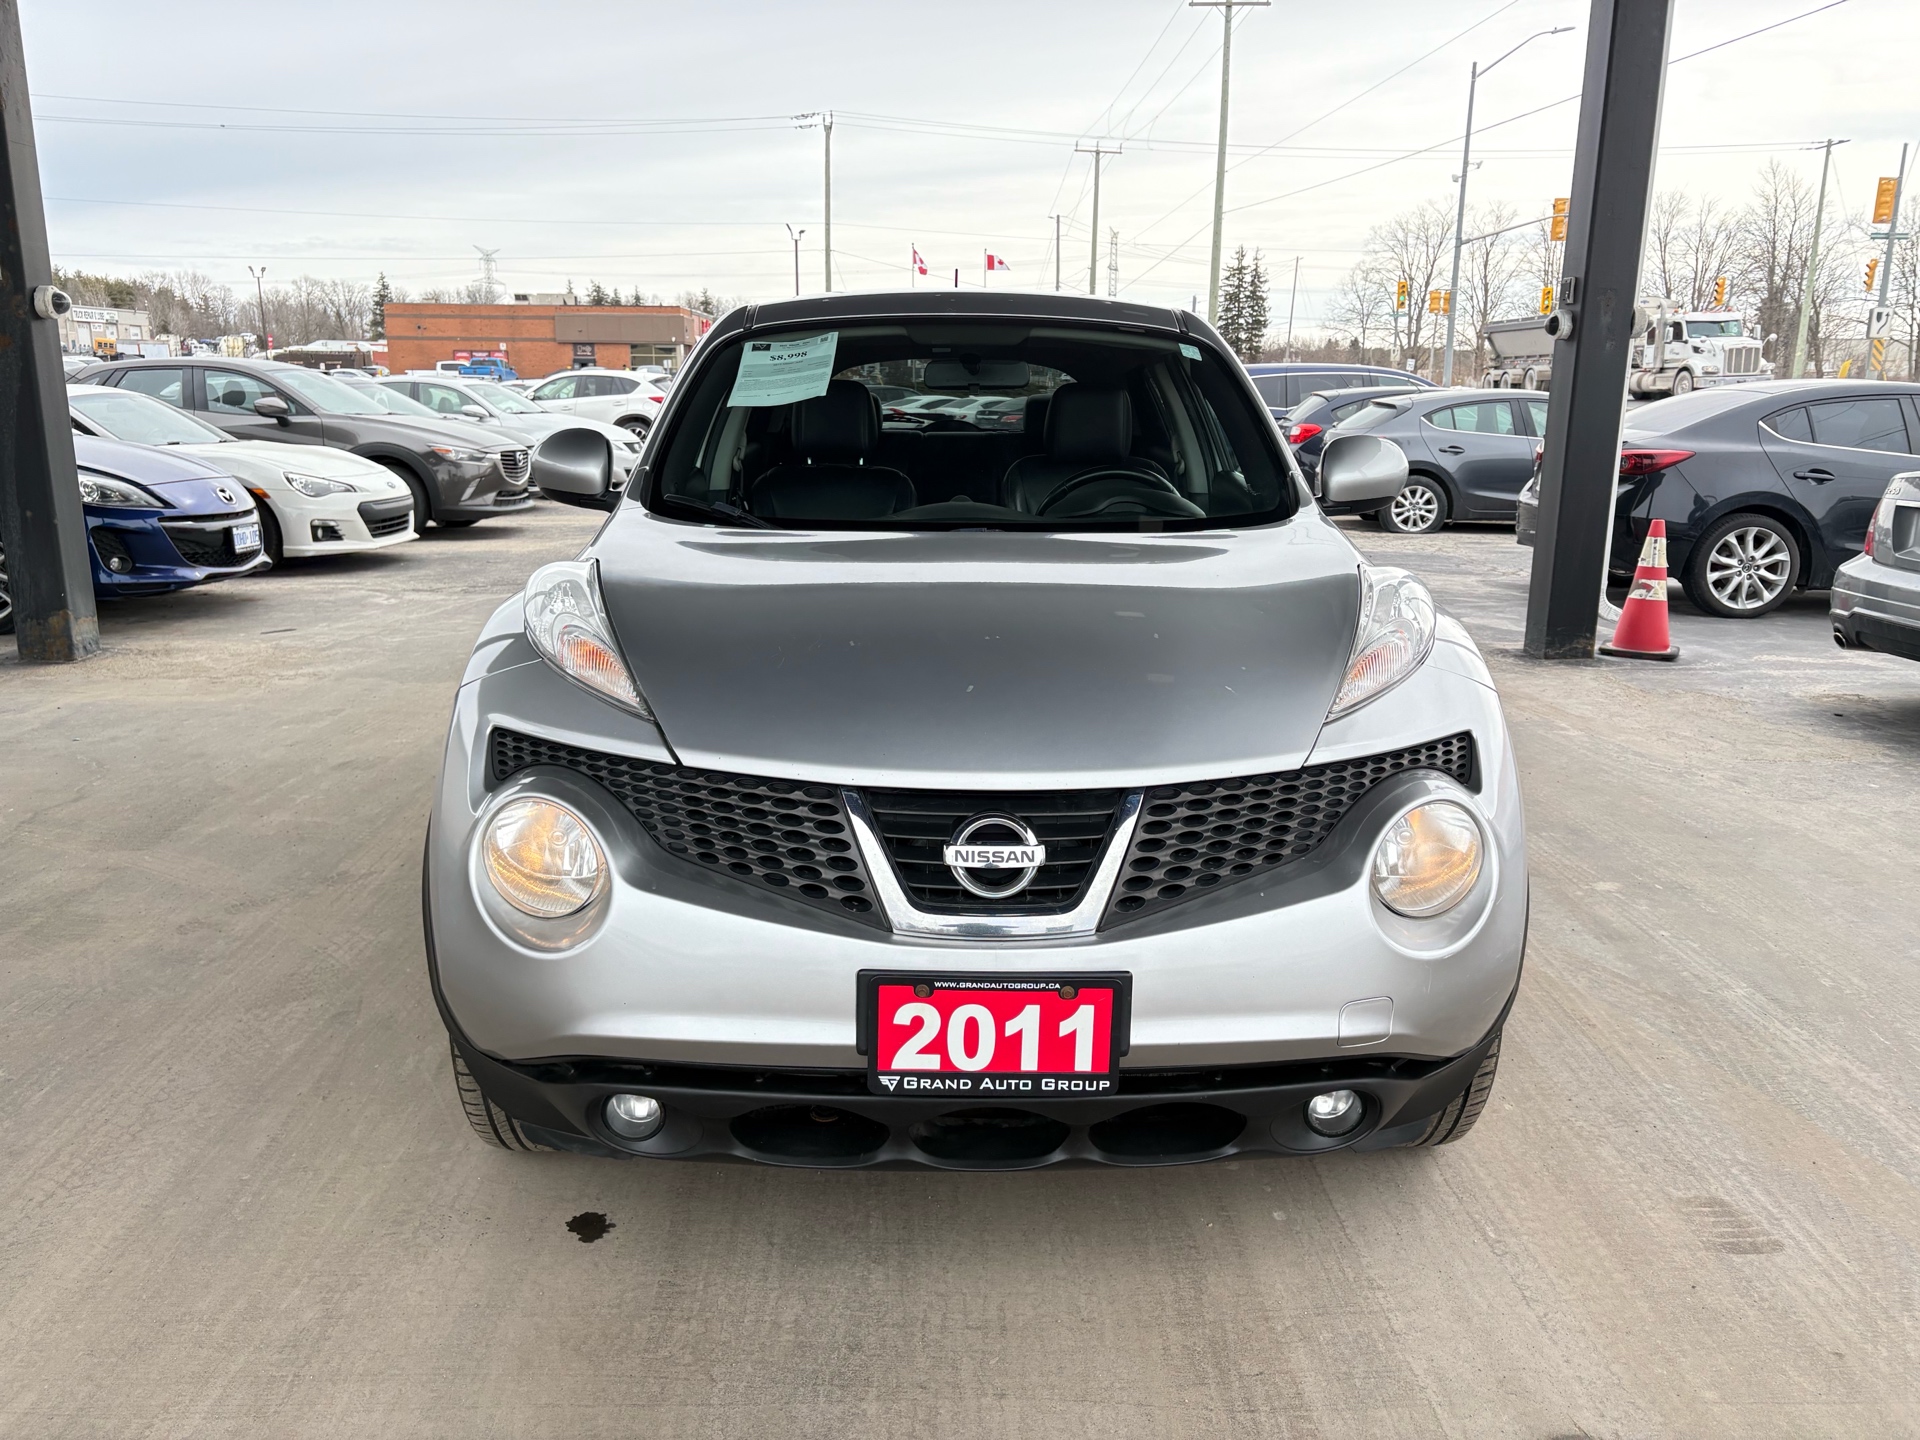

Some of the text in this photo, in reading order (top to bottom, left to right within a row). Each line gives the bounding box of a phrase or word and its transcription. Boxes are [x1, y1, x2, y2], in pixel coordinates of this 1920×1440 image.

[769, 350, 808, 361] $8,998
[954, 849, 1035, 864] NISSAN
[933, 981, 1061, 990] WWW.GRANDAUTOGROUP.CA
[891, 1002, 1095, 1072] 2011
[903, 1076, 1111, 1092] GRAND AUTO GROUP
